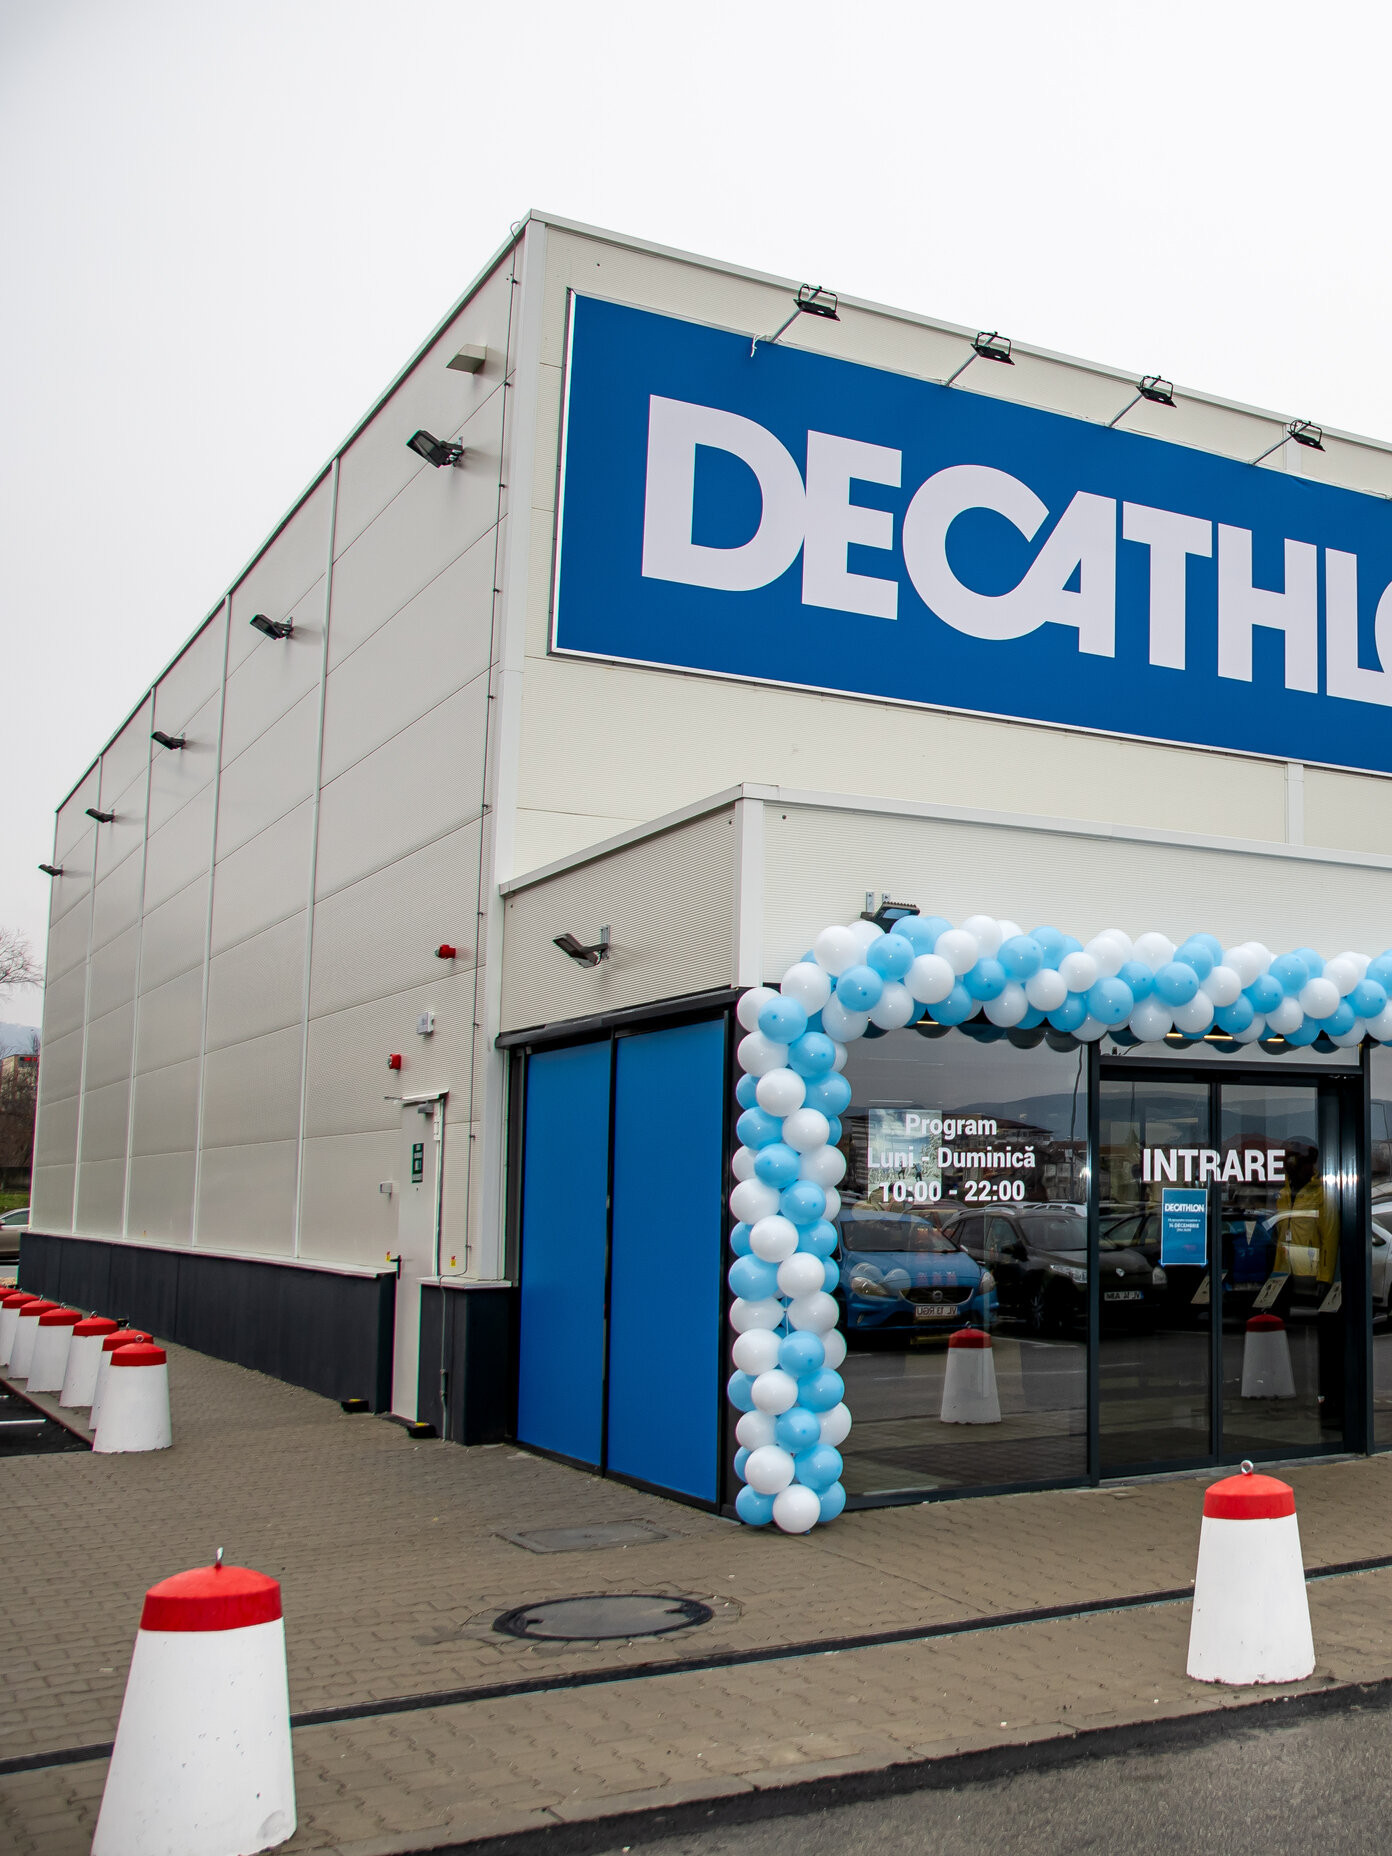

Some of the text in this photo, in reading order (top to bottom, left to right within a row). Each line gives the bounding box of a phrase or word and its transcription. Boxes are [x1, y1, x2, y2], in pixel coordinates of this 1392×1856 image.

[905, 1113, 998, 1141] Program
[867, 1145, 914, 1169] Luni
[937, 1145, 1036, 1169] Duminică
[1143, 1148, 1286, 1182] INTRARE
[879, 1180, 942, 1203] 10:00
[964, 1179, 1026, 1202] 22:00
[1164, 1203, 1205, 1212] DECATHLON
